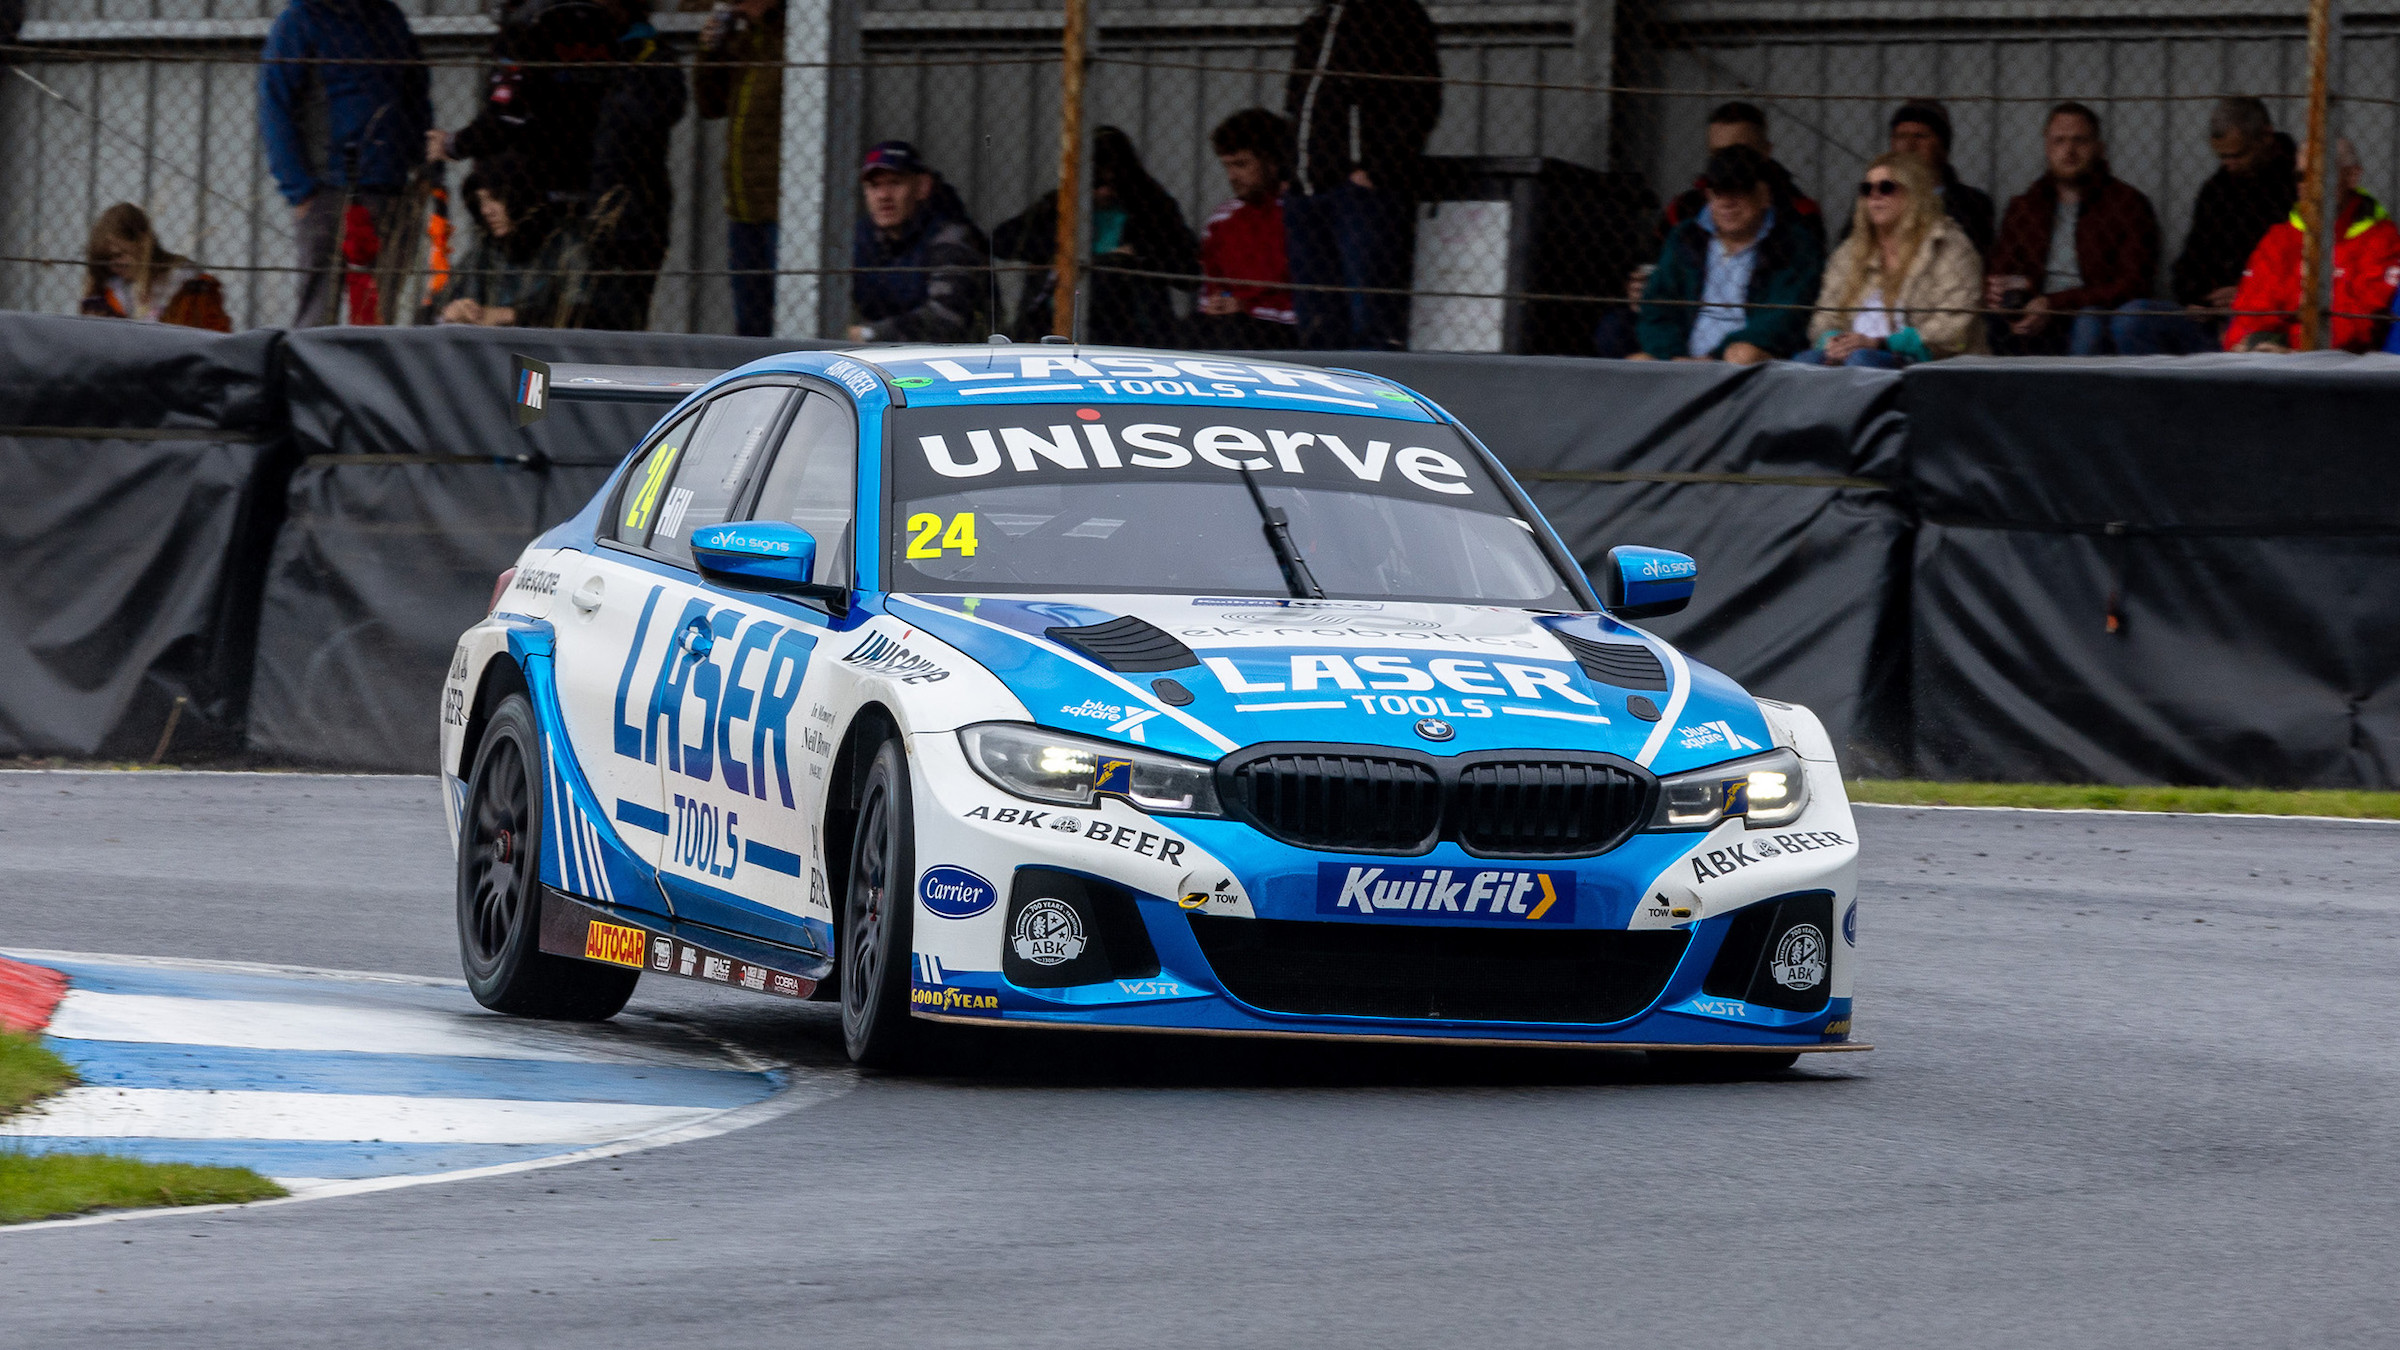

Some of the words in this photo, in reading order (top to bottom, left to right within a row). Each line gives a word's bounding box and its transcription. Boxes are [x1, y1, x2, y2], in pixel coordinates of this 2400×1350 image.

[845, 370, 878, 399] BEER
[922, 355, 1364, 395] LASER
[1089, 379, 1246, 398] TOOLS
[625, 443, 677, 529] 24
[654, 486, 695, 539] Hill
[749, 538, 790, 552] signs
[906, 512, 978, 559] 24
[1202, 655, 1600, 706] LASER
[614, 585, 819, 811] LASER
[1081, 699, 1121, 714] blue
[1351, 695, 1494, 718] TOOLS
[1060, 705, 1121, 721] square
[1678, 725, 1711, 738] blue
[1680, 732, 1724, 749] square
[674, 793, 738, 880] TOOLS
[963, 806, 1050, 828] ABK
[1084, 820, 1185, 867] BEER
[1691, 842, 1760, 884] ABK
[1773, 831, 1854, 854] BEER
[926, 877, 983, 903] Carrier
[1215, 894, 1238, 904] TOW
[1648, 908, 1669, 917] TOW
[587, 923, 645, 966] AUTOCAR
[1032, 941, 1067, 955] ABK
[774, 975, 798, 990] COBRA
[1788, 967, 1814, 981] ABK
[1118, 982, 1179, 995] WSR
[1692, 1000, 1745, 1016] WSR
